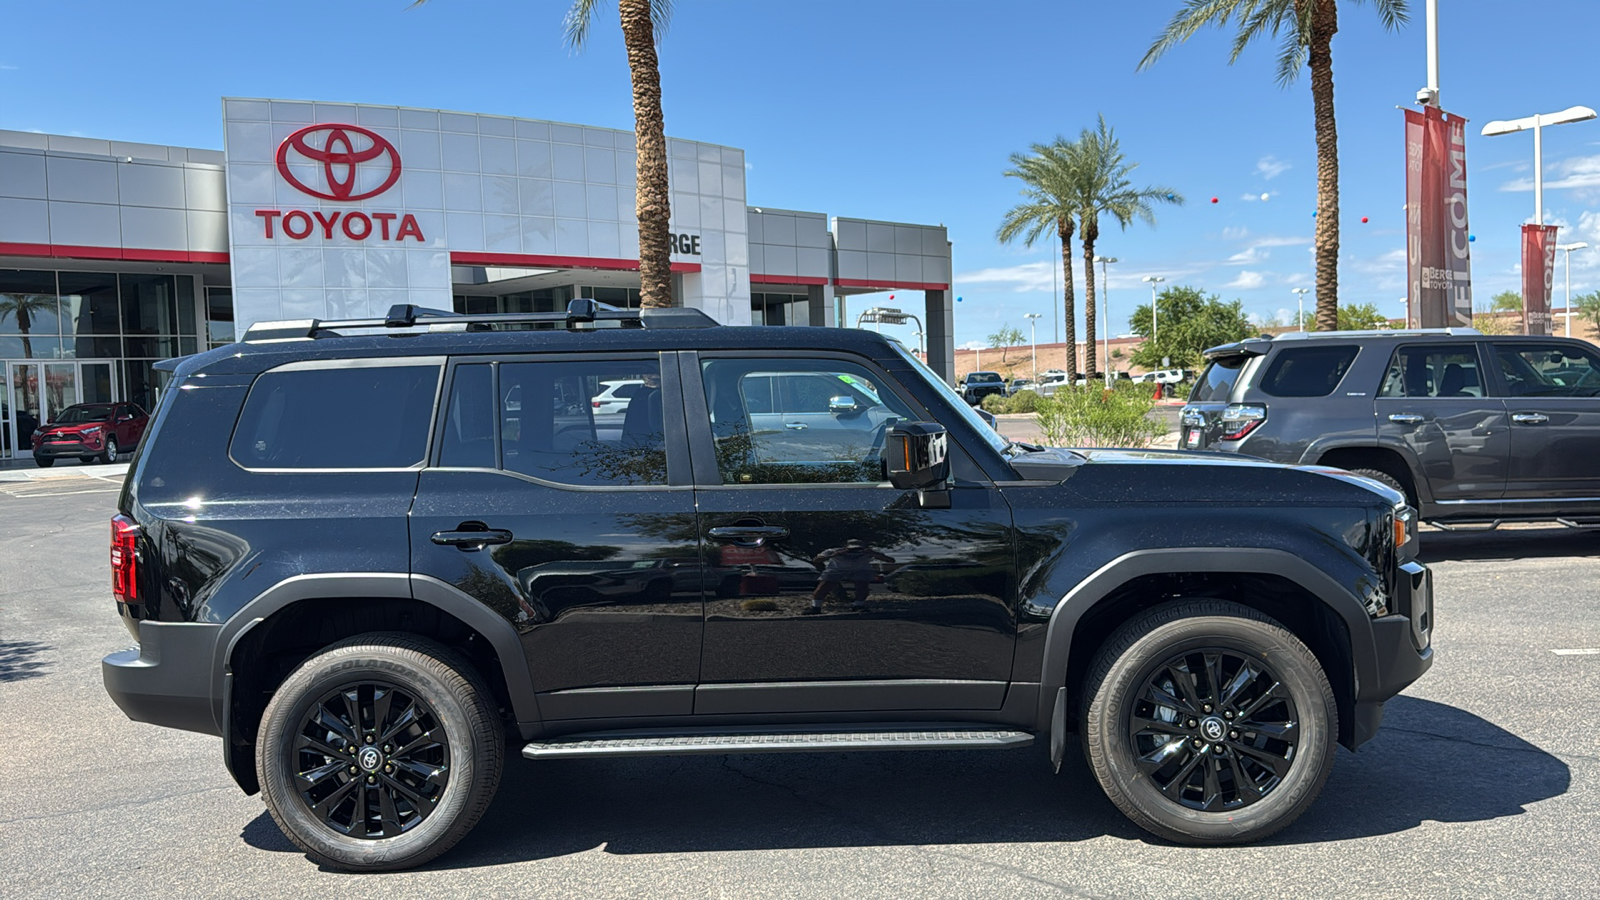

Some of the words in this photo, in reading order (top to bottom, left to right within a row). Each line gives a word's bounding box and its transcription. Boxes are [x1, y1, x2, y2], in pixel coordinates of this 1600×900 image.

[255, 209, 426, 242] TOYOTA
[668, 233, 702, 256] RGE
[1430, 280, 1453, 290] TOYOTA
[1544, 228, 1557, 334] ELCOME
